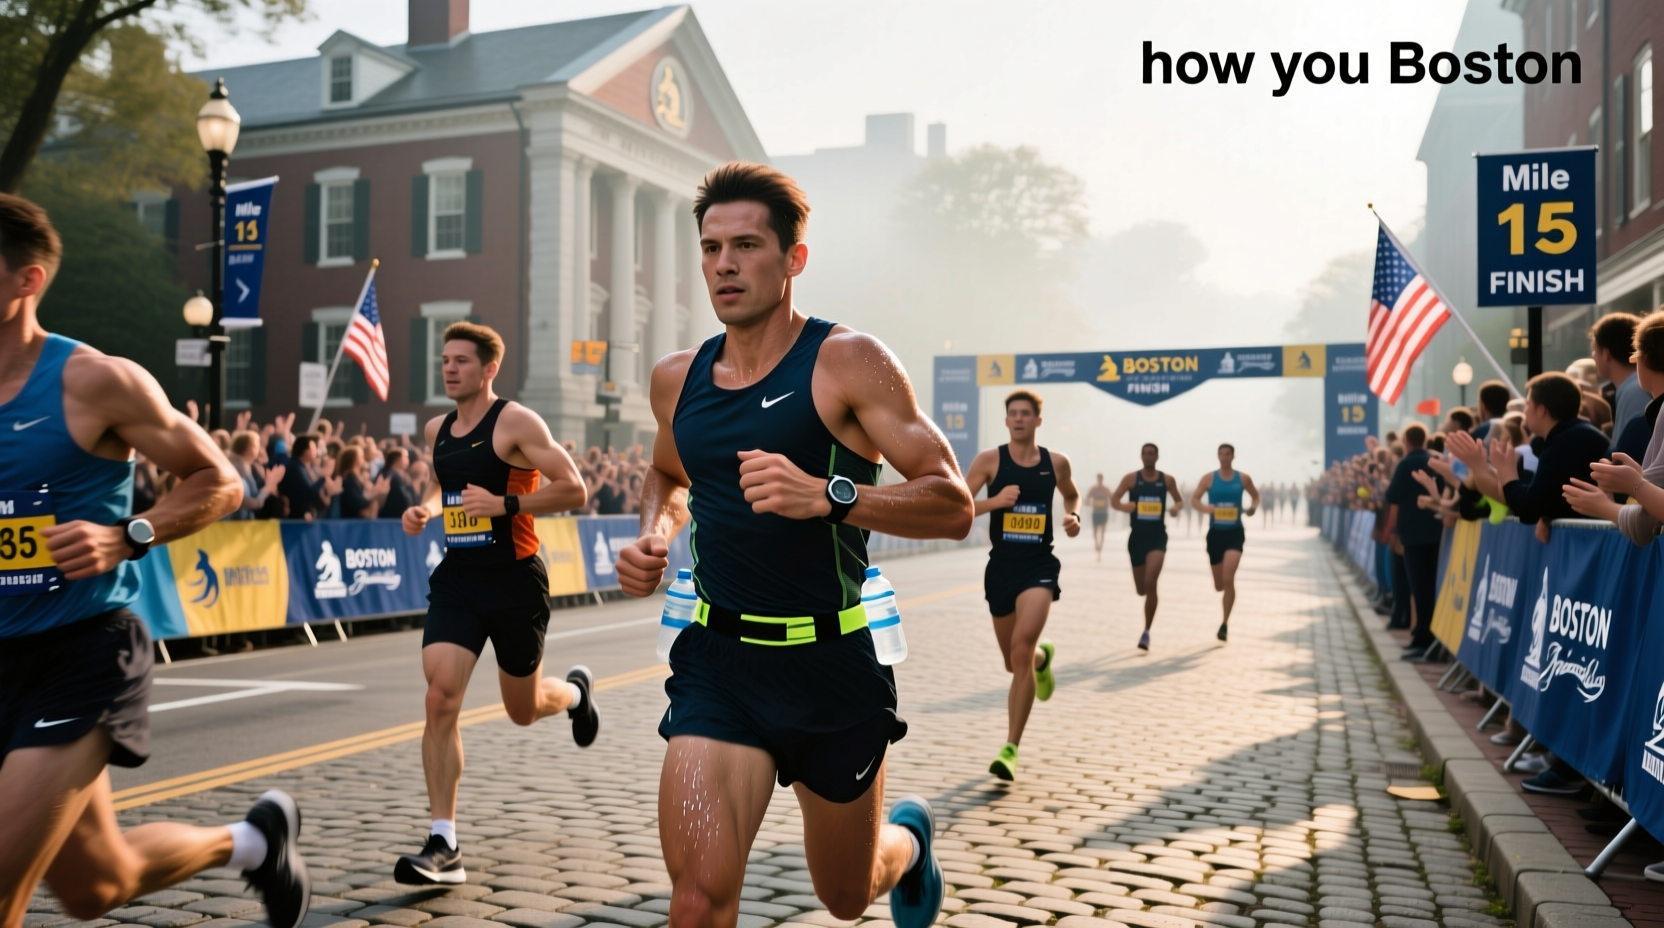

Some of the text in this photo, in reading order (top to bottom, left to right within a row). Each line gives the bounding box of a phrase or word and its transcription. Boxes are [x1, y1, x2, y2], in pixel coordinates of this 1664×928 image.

[1502, 162, 1570, 192] Mile
[1497, 201, 1578, 255] 15
[1489, 268, 1585, 295] FINISH
[1123, 355, 1199, 374] BOSTON
[345, 548, 397, 569] BOSTON
[1549, 594, 1612, 651] BOSTON
